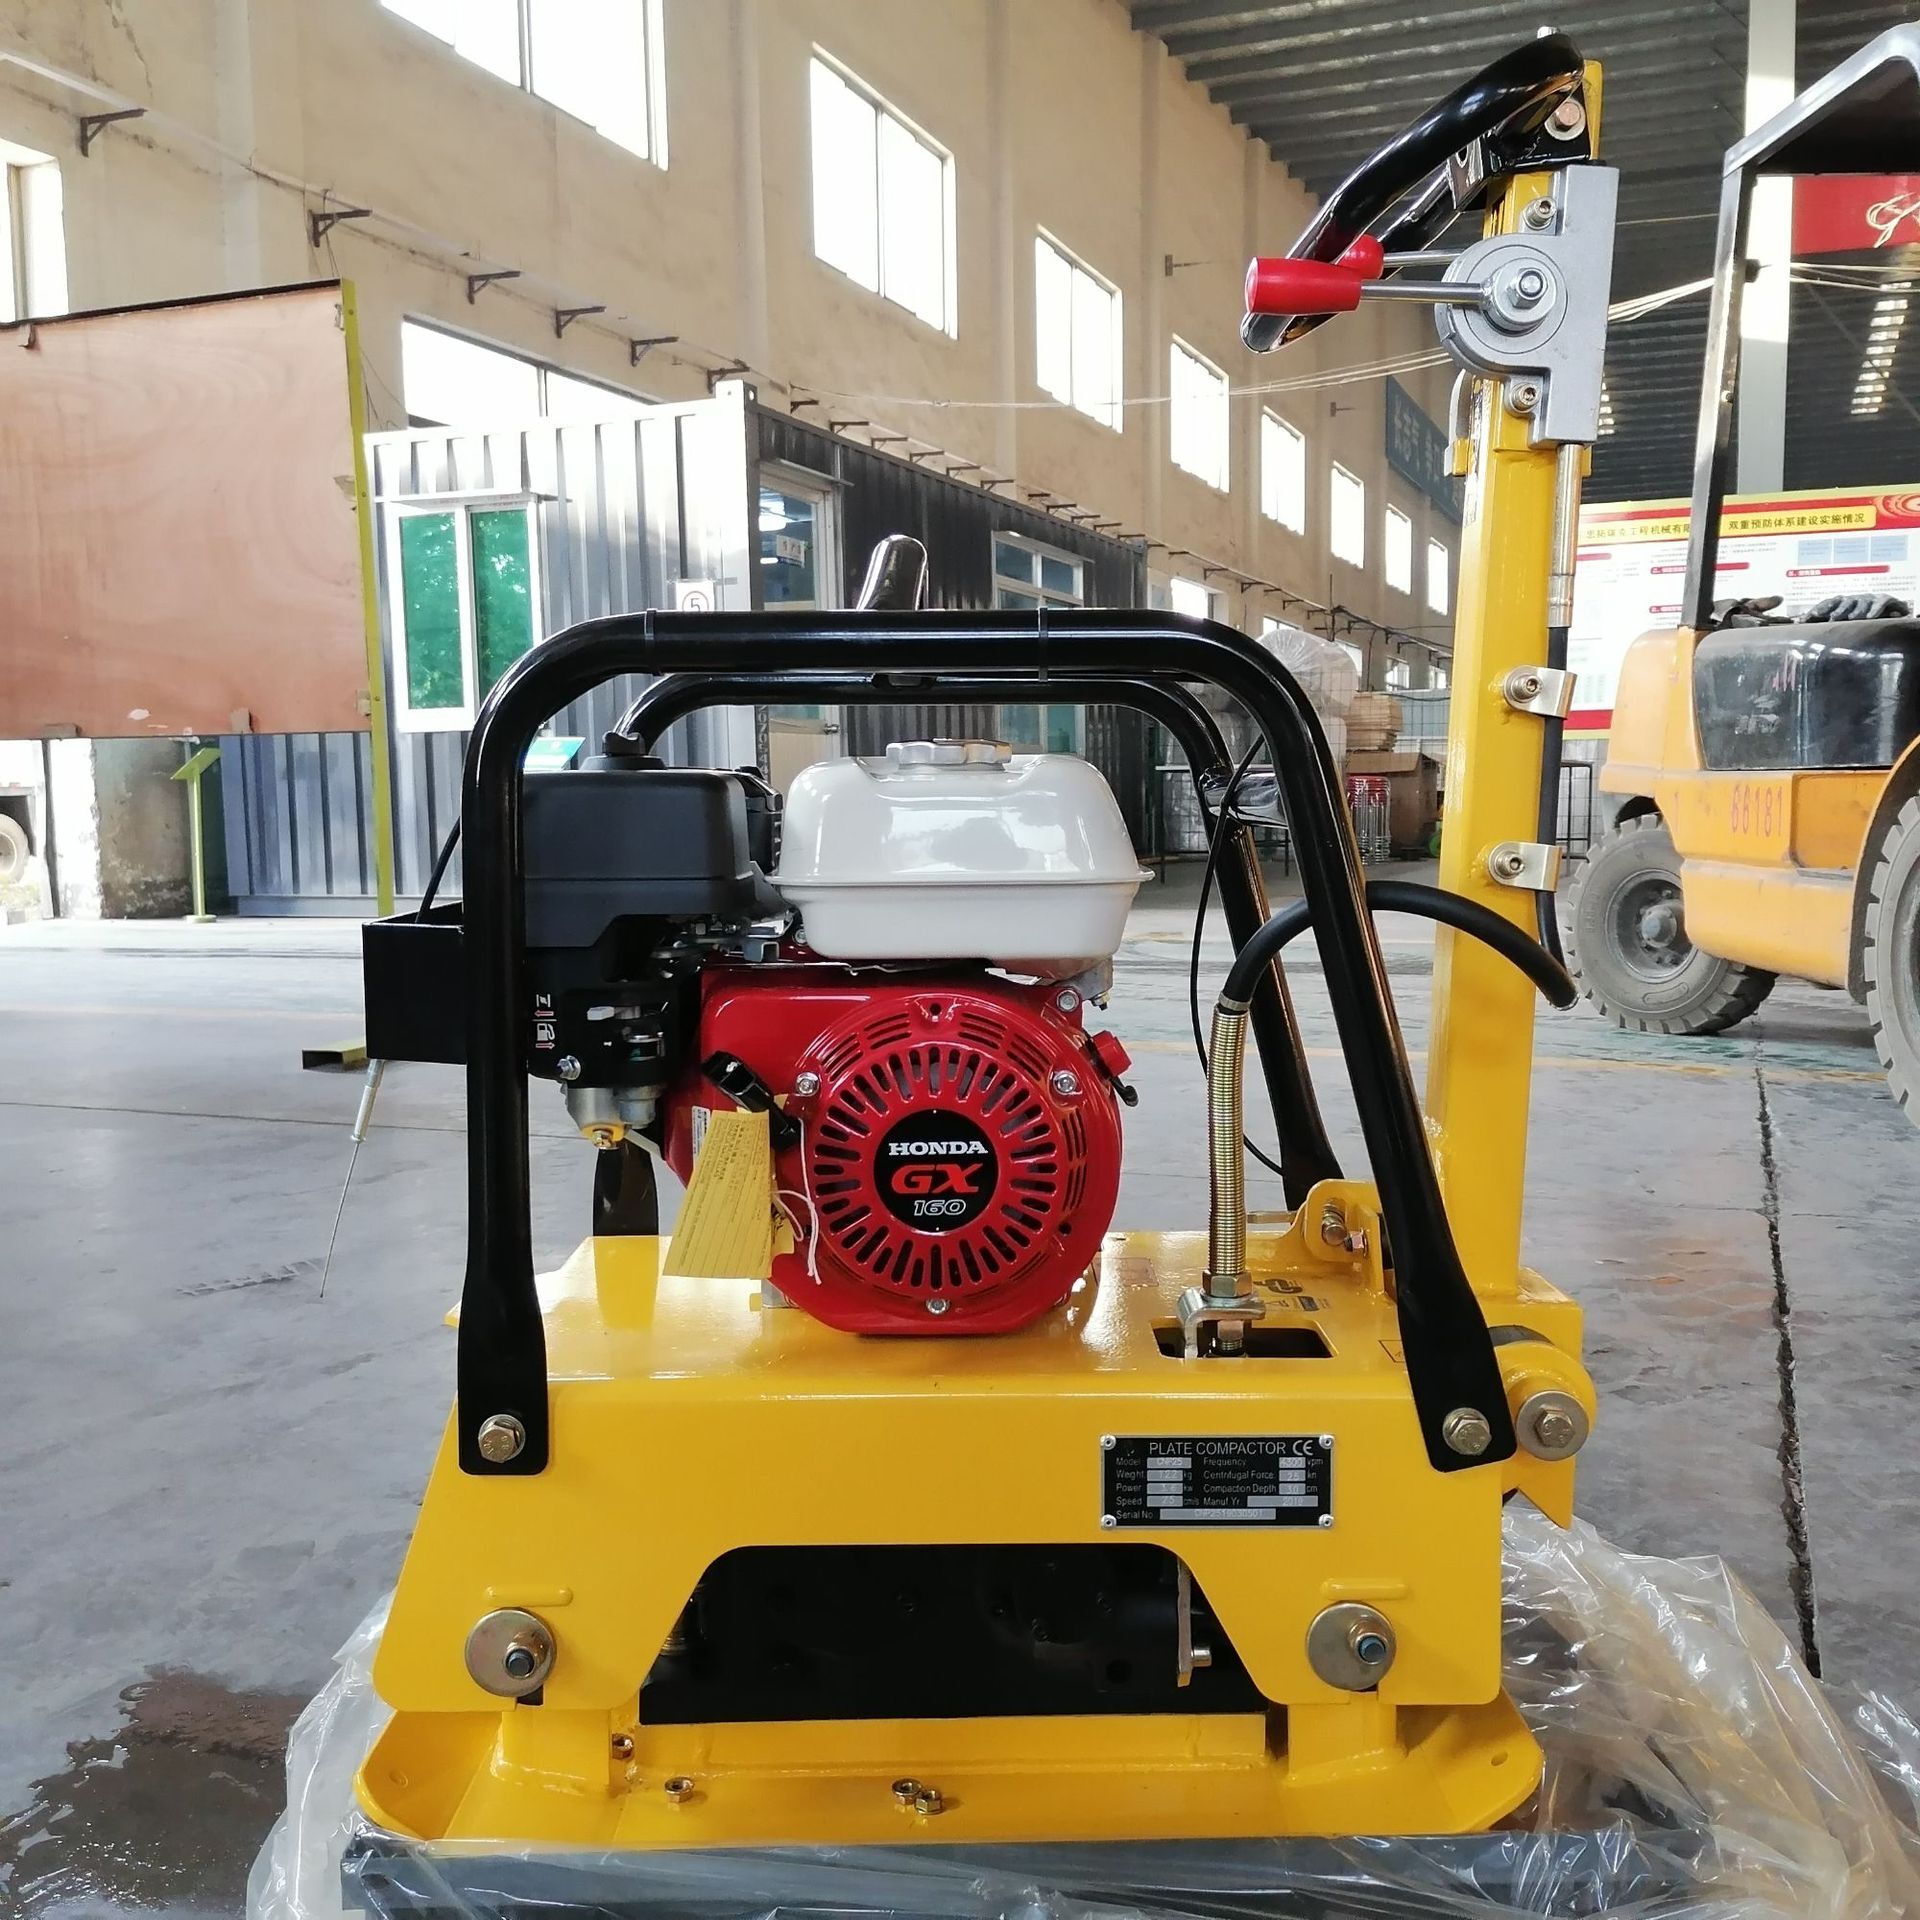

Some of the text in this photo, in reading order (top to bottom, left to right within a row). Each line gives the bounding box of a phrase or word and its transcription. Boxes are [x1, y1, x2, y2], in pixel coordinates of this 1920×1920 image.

[1731, 784, 1782, 838] 66181
[888, 1141, 988, 1156] HONDA
[891, 1163, 983, 1194] GX
[914, 1199, 966, 1217] 160
[1149, 1440, 1313, 1456] PLATE COMPACTOR CE
[1116, 1457, 1140, 1466] Model
[1203, 1457, 1246, 1466] Frequency
[1116, 1470, 1144, 1480] Weight
[1203, 1470, 1249, 1480] Centrifugal
[1116, 1483, 1142, 1492] Power
[1203, 1484, 1251, 1494] Compaction
[1252, 1484, 1277, 1493] Depth
[1116, 1496, 1142, 1507] Speed
[1116, 1510, 1140, 1520] Serial
